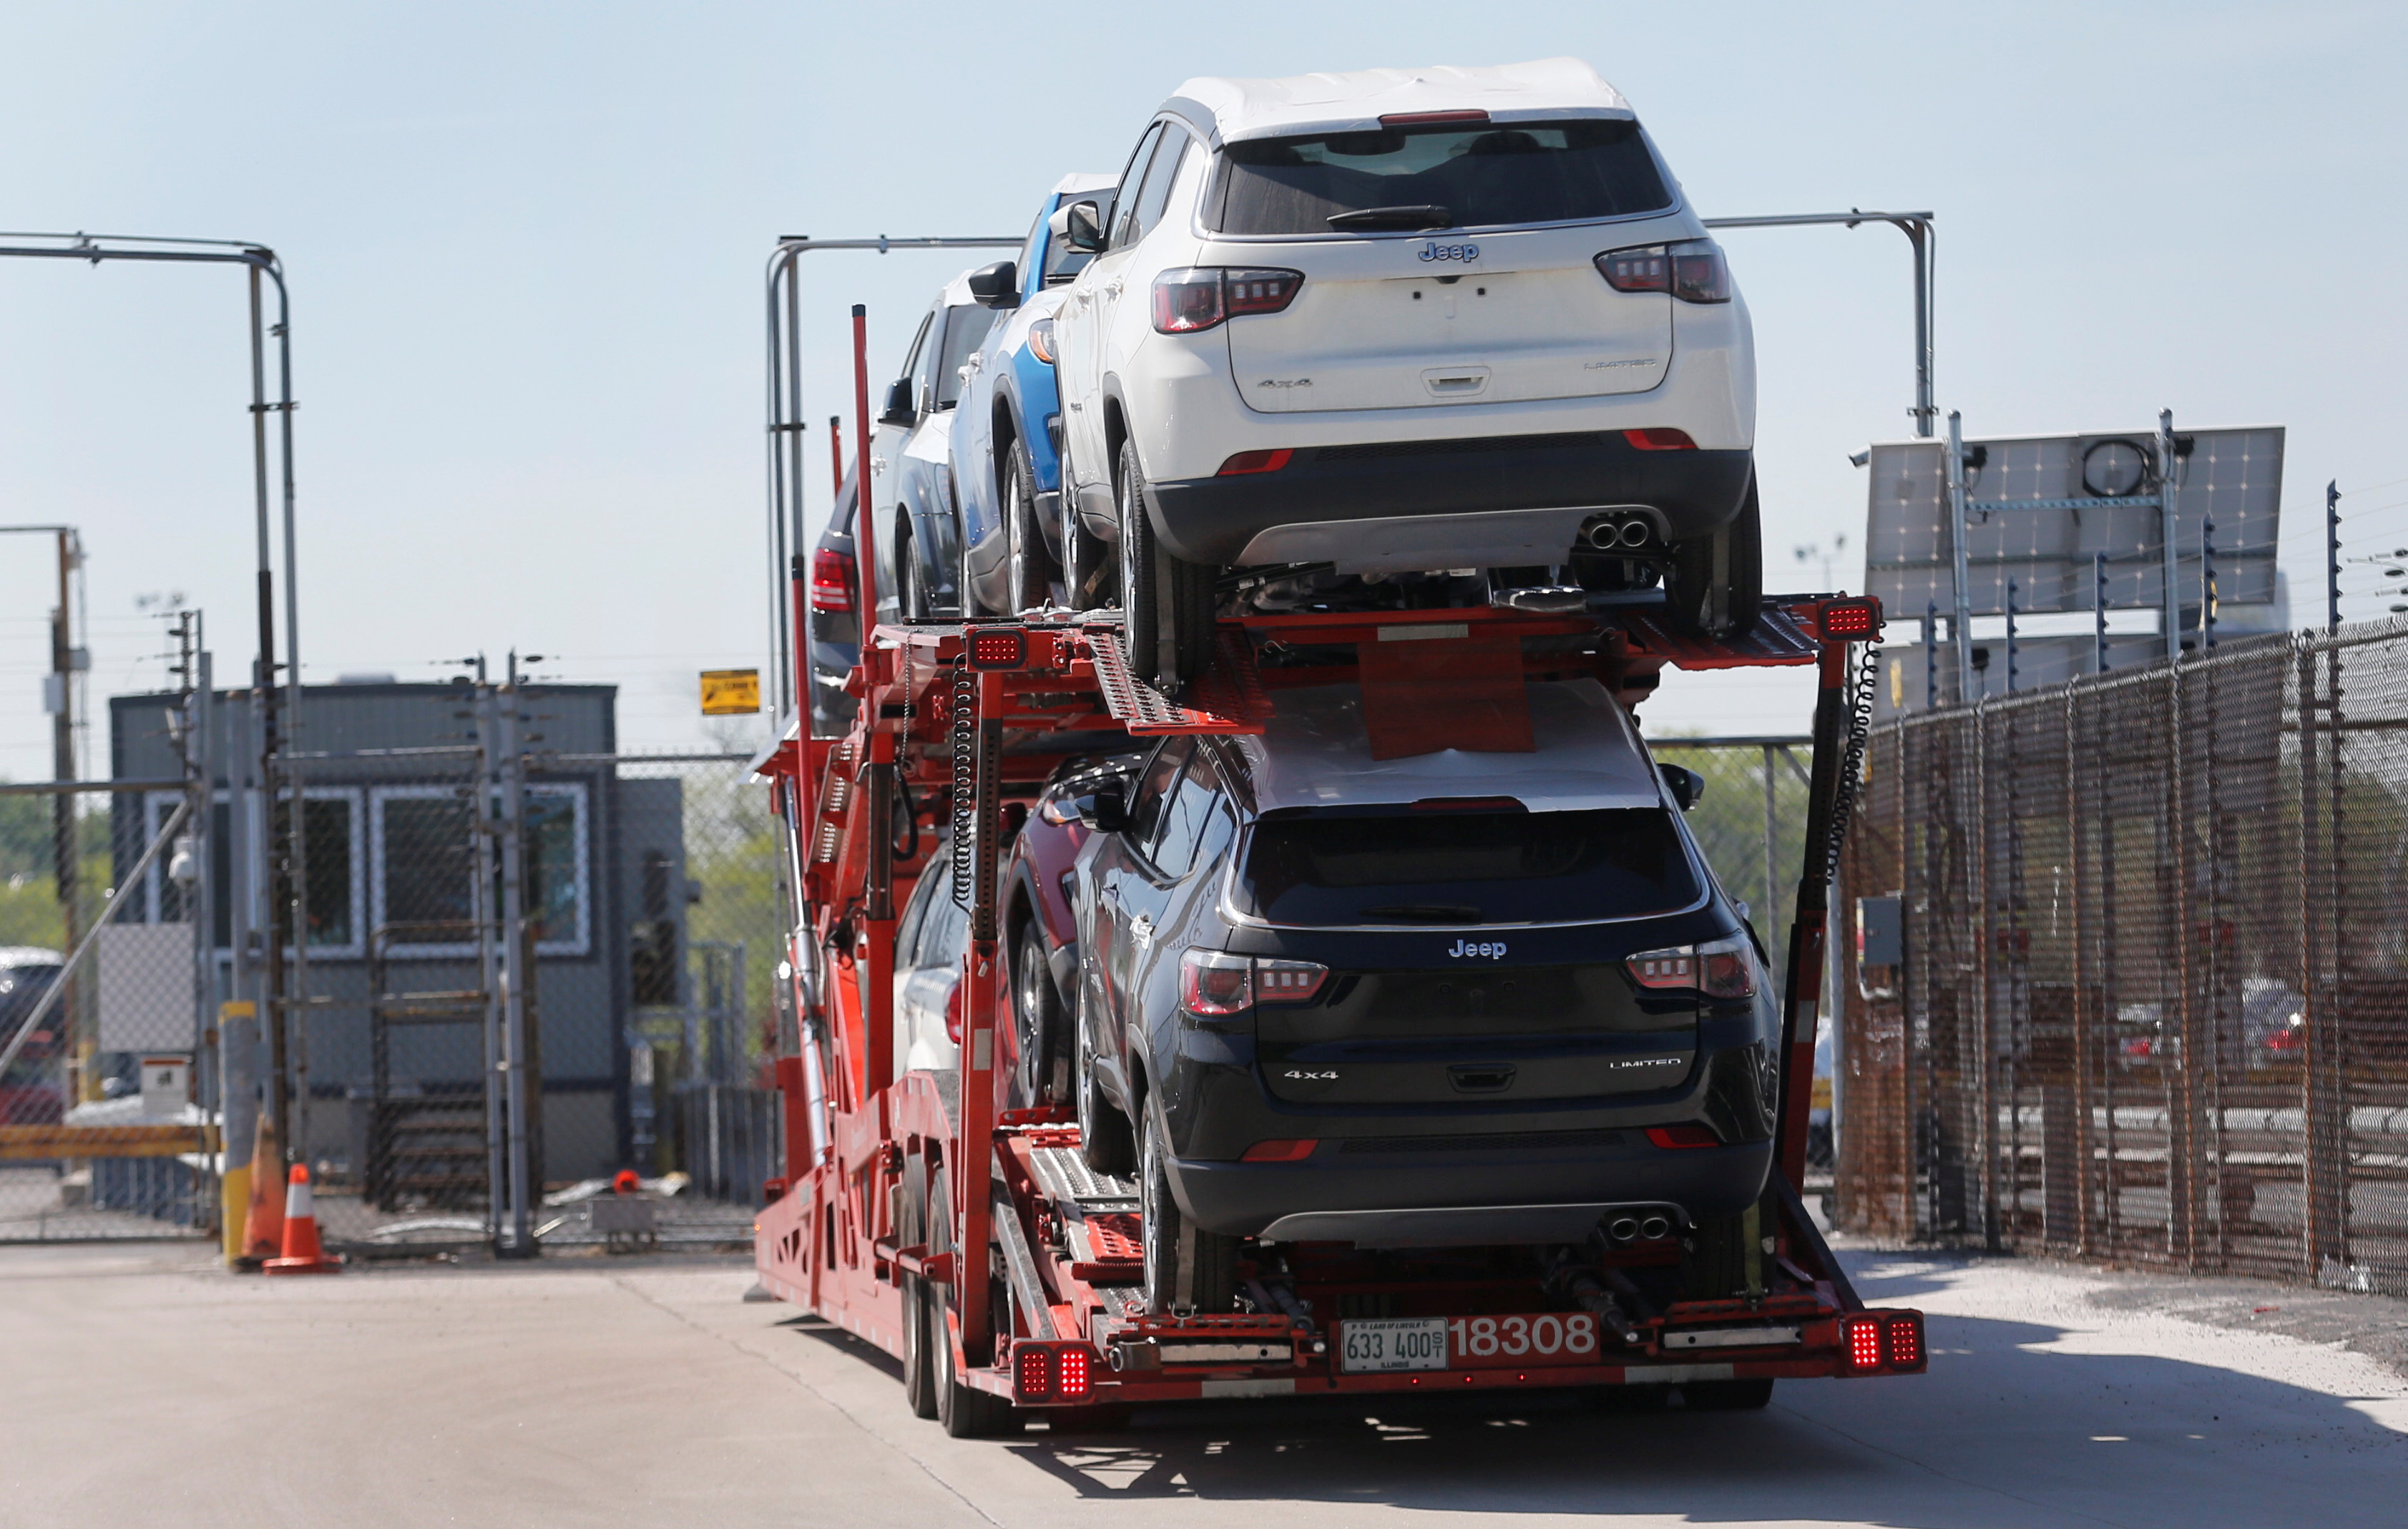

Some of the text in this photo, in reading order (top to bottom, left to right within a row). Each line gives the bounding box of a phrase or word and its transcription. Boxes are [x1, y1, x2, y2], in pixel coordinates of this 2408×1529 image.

[1419, 243, 1479, 263] Jeep
[1585, 358, 1657, 371] LIMITED
[1448, 939, 1507, 959] Jeep
[1610, 1058, 1681, 1069] LIMITED
[1284, 1070, 1338, 1079] 4x4
[1347, 1333, 1383, 1359] 633
[1396, 1332, 1431, 1359] 400
[1449, 1314, 1595, 1357] 18308
